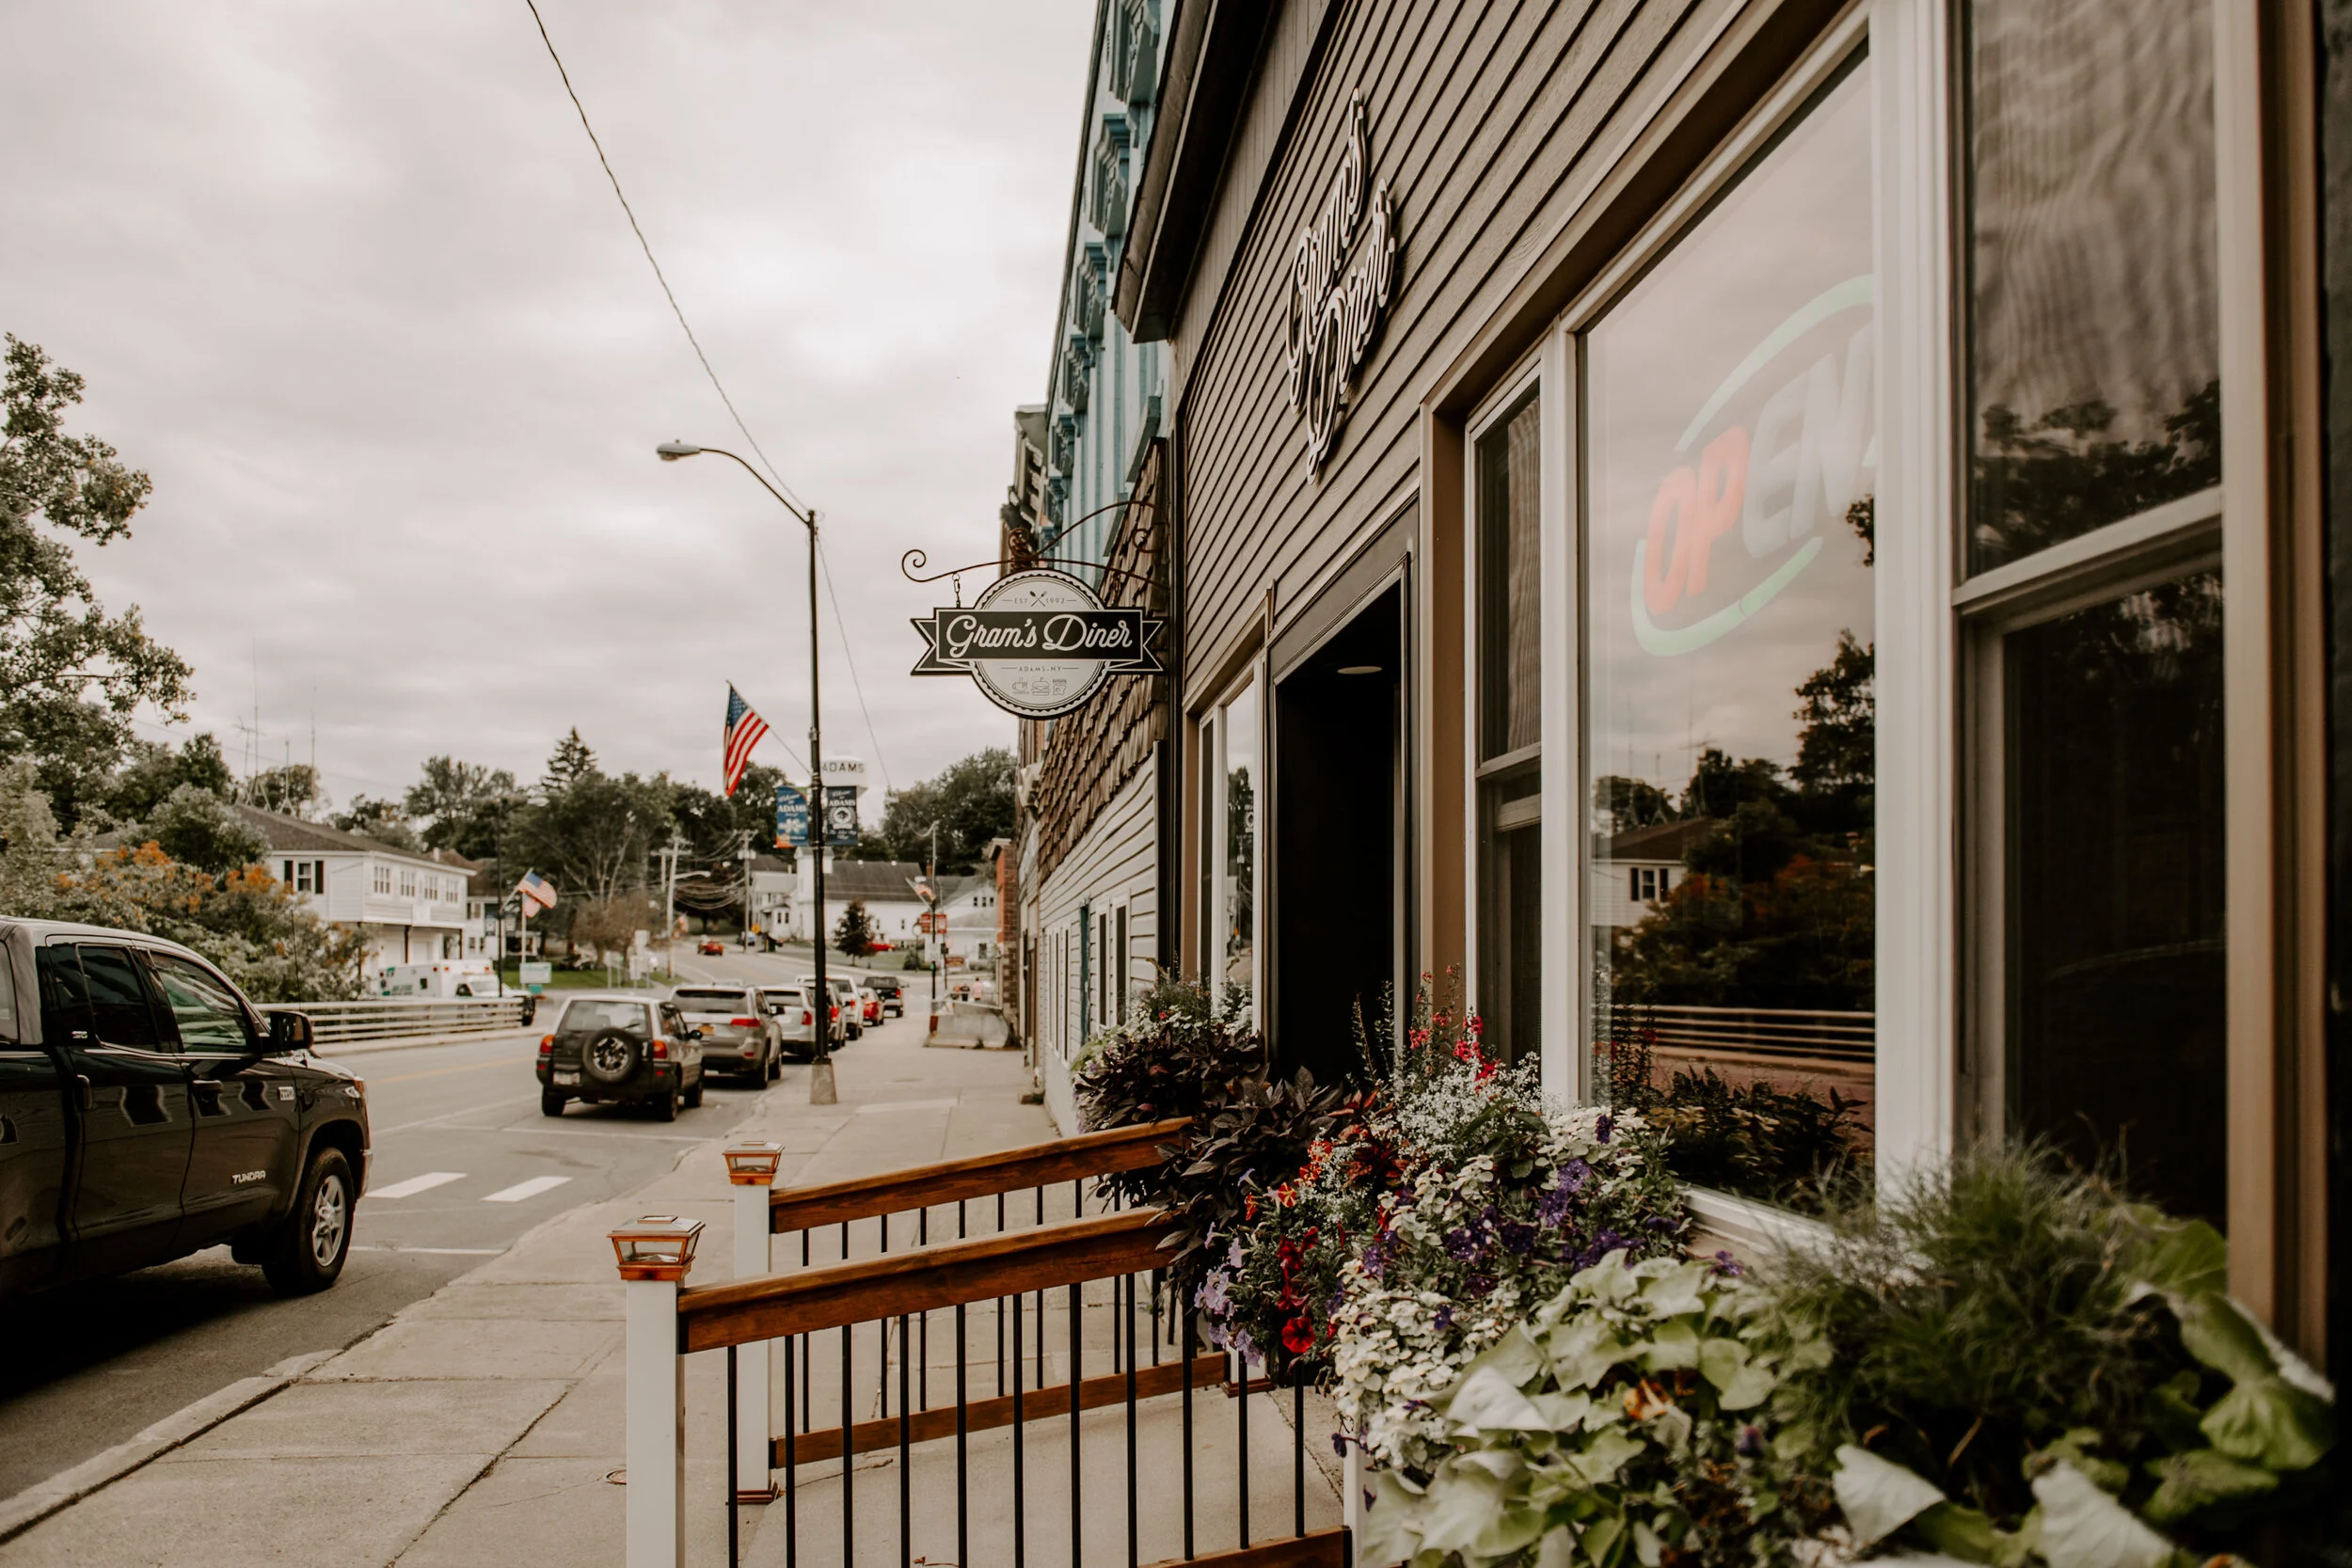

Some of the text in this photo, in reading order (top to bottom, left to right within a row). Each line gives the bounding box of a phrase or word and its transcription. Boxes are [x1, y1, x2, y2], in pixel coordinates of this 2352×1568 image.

[1306, 177, 1395, 485] Diner
[1644, 321, 1875, 616] OPEN
[946, 613, 1133, 657] Gram's Diner
[821, 762, 865, 773] ADAMS
[778, 804, 806, 813] ADAMS
[231, 1170, 266, 1184] TUNDRA
